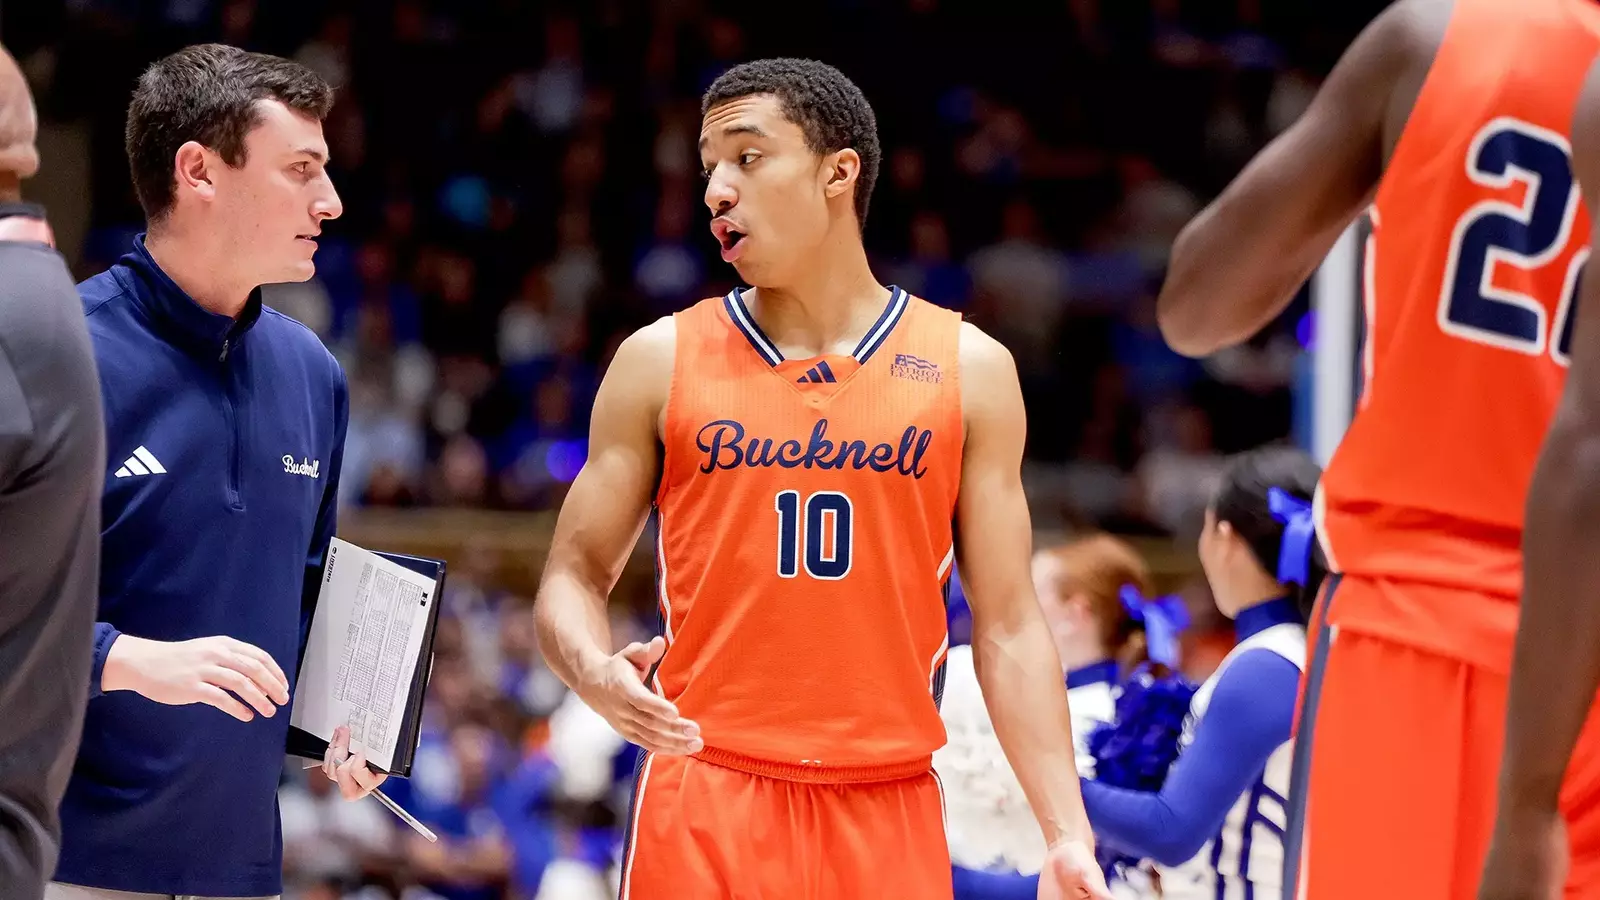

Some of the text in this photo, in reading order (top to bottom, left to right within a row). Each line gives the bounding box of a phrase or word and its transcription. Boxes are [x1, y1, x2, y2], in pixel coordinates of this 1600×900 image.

[1437, 116, 1592, 367] 2
[890, 364, 943, 378] PATRIOT
[890, 370, 943, 384] LEAGUE
[282, 454, 319, 478] Bucknll
[696, 418, 932, 479] Bucknell
[775, 489, 853, 580] 10
